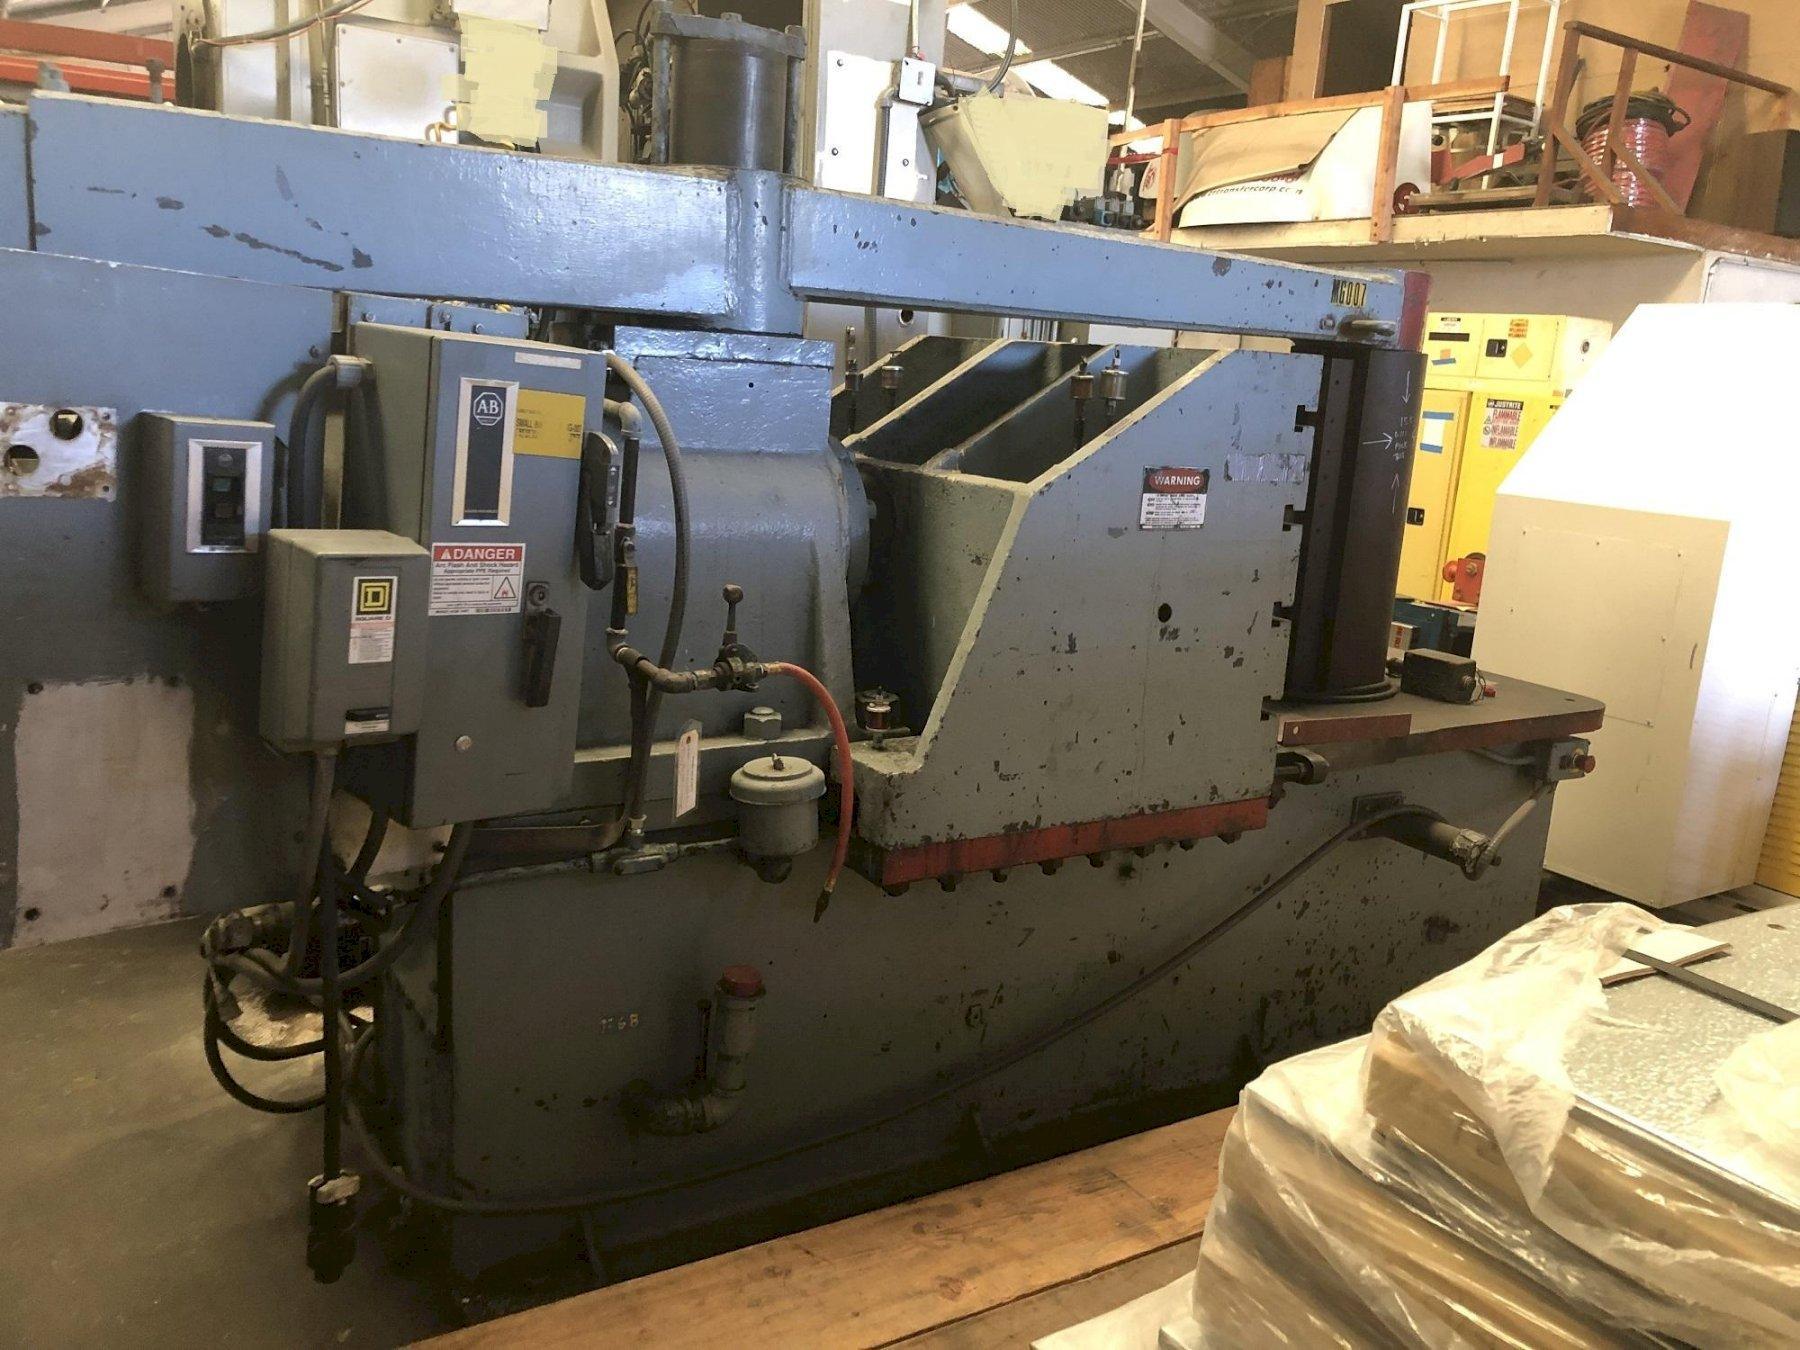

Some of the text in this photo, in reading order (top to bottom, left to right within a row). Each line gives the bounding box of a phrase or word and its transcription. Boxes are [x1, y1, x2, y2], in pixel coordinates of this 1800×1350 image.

[1331, 279, 1366, 306] MG007
[477, 400, 499, 414] AB
[1495, 400, 1522, 409] JUSTRITE
[1154, 476, 1201, 486] WARNING
[453, 548, 516, 560] DANGER
